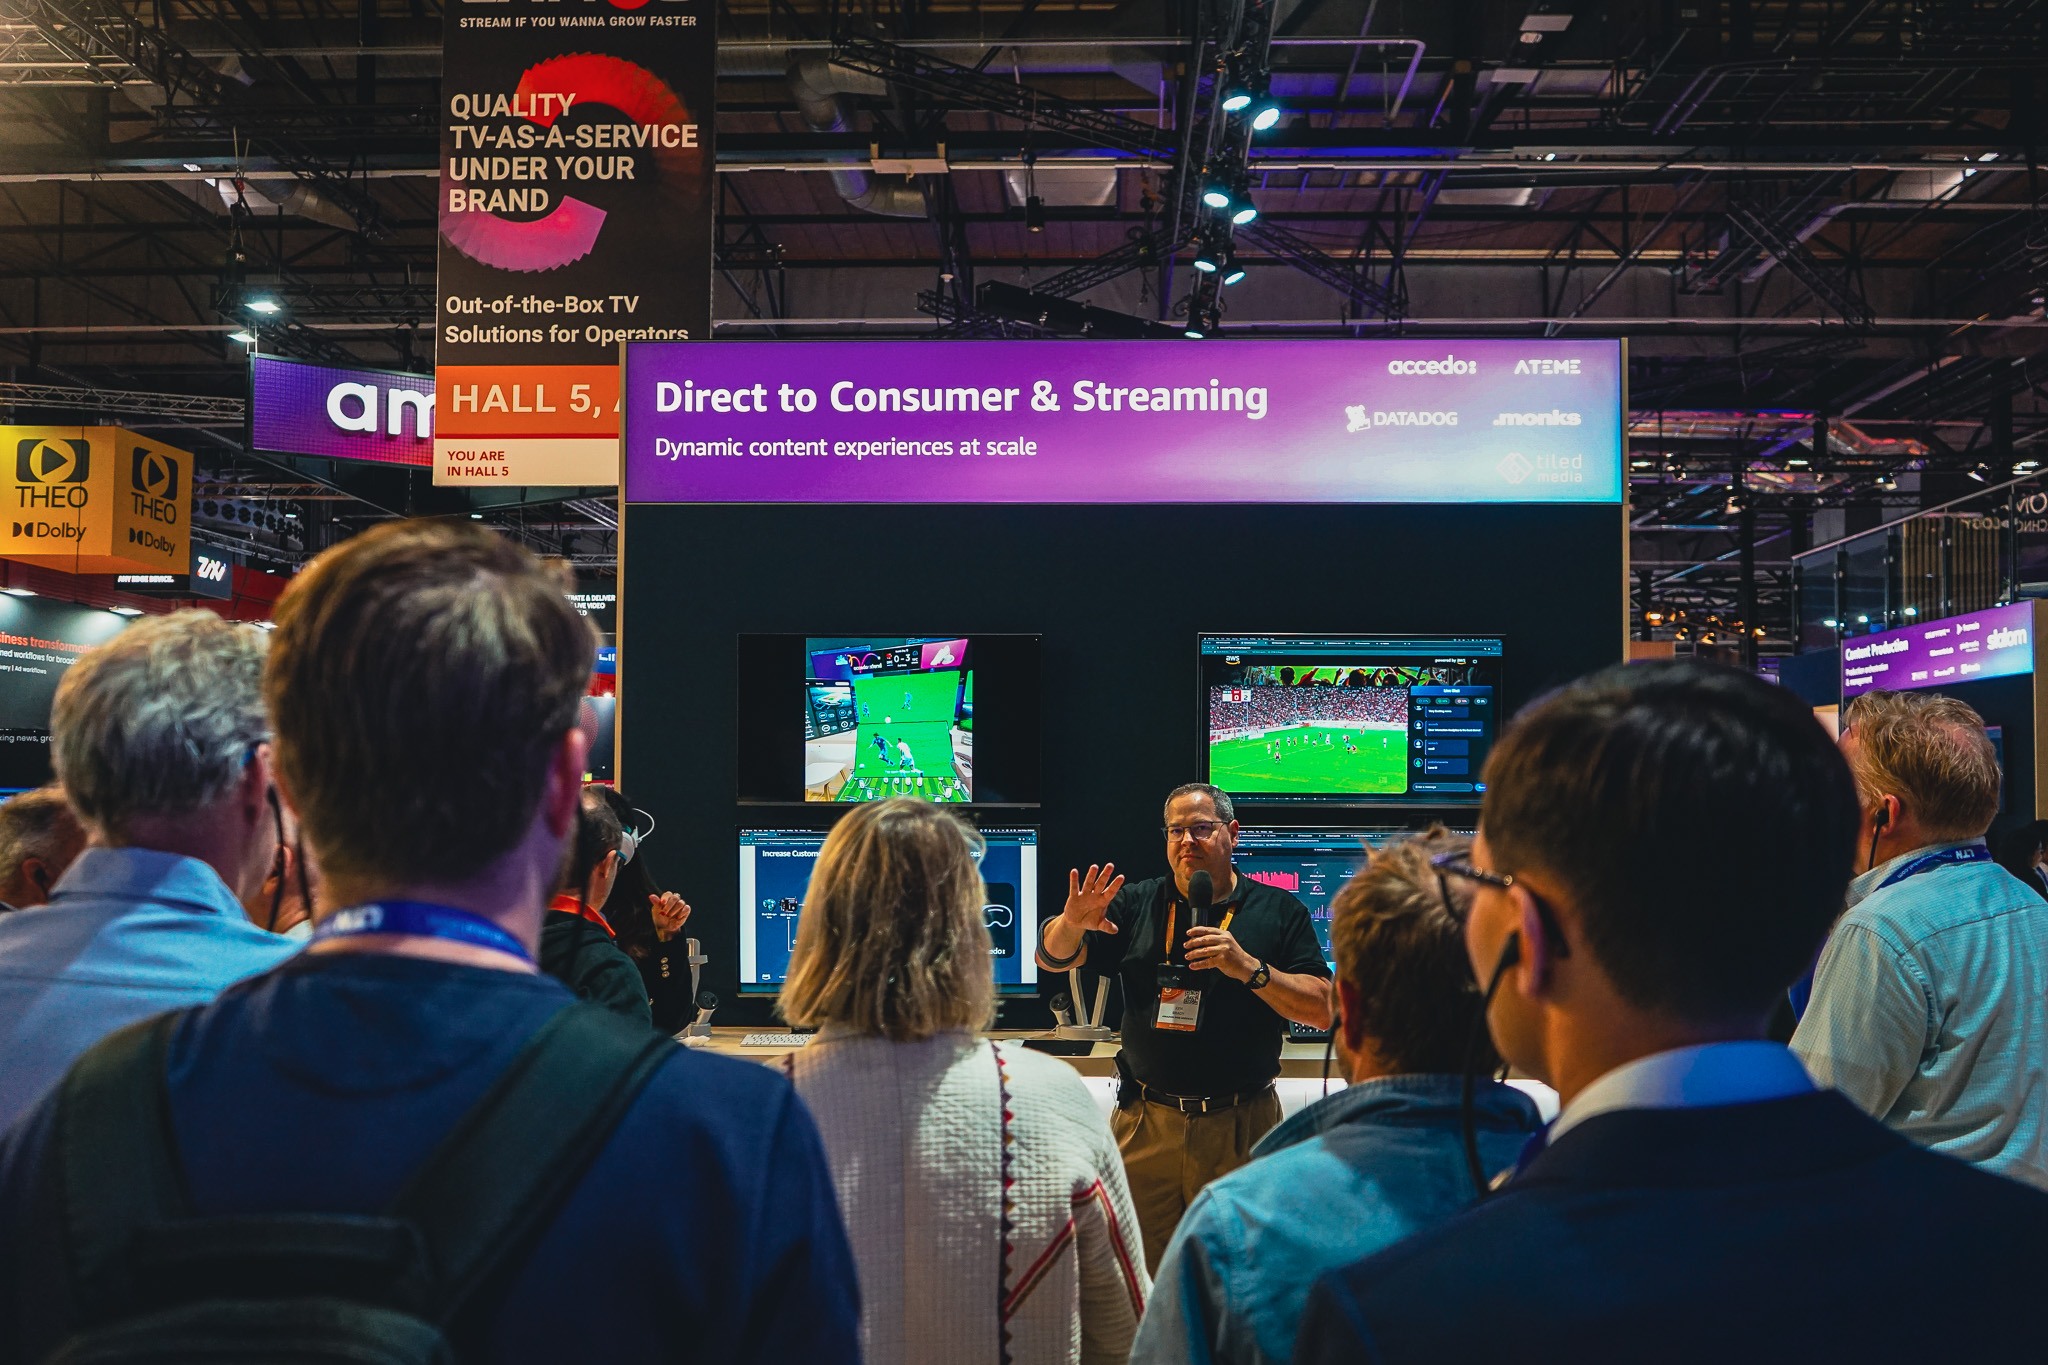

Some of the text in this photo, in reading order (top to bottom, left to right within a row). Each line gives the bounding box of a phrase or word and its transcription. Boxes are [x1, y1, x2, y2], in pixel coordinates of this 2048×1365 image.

[460, 16, 697, 28] STREAM IF YOU WANNA GROW FASTER
[450, 92, 576, 120] QUALITY
[450, 124, 698, 149] TV-AS-A-SERVICE
[449, 156, 635, 181] UNDER YOUR
[449, 188, 549, 212] BRAND
[445, 295, 640, 315] Out-of-the-Box TV
[445, 324, 689, 347] Solutions for Operators
[1514, 359, 1581, 375] ATEME
[452, 384, 556, 413] HALL
[569, 383, 601, 419] 5,
[655, 379, 768, 413] Direct
[778, 383, 817, 413] to
[830, 380, 1020, 413] Consumer
[1030, 380, 1060, 412] &
[1072, 378, 1268, 420] Streaming
[1373, 411, 1458, 426] DATADOG
[1492, 410, 1582, 426] .monks
[447, 450, 505, 461] YOU ARE
[655, 436, 1038, 461] Dynamic content experiences at scale
[447, 466, 510, 477] IN HALL 5
[1536, 454, 1583, 470] tiled
[1537, 471, 1583, 483] media
[15, 486, 89, 508] THEO
[131, 491, 177, 525] THEO
[37, 522, 87, 543] Dolby
[145, 532, 176, 557] Dolby
[45, 654, 55, 663] for
[1845, 645, 1871, 661] Content
[1871, 638, 1909, 657] Production
[16, 735, 39, 743] news,
